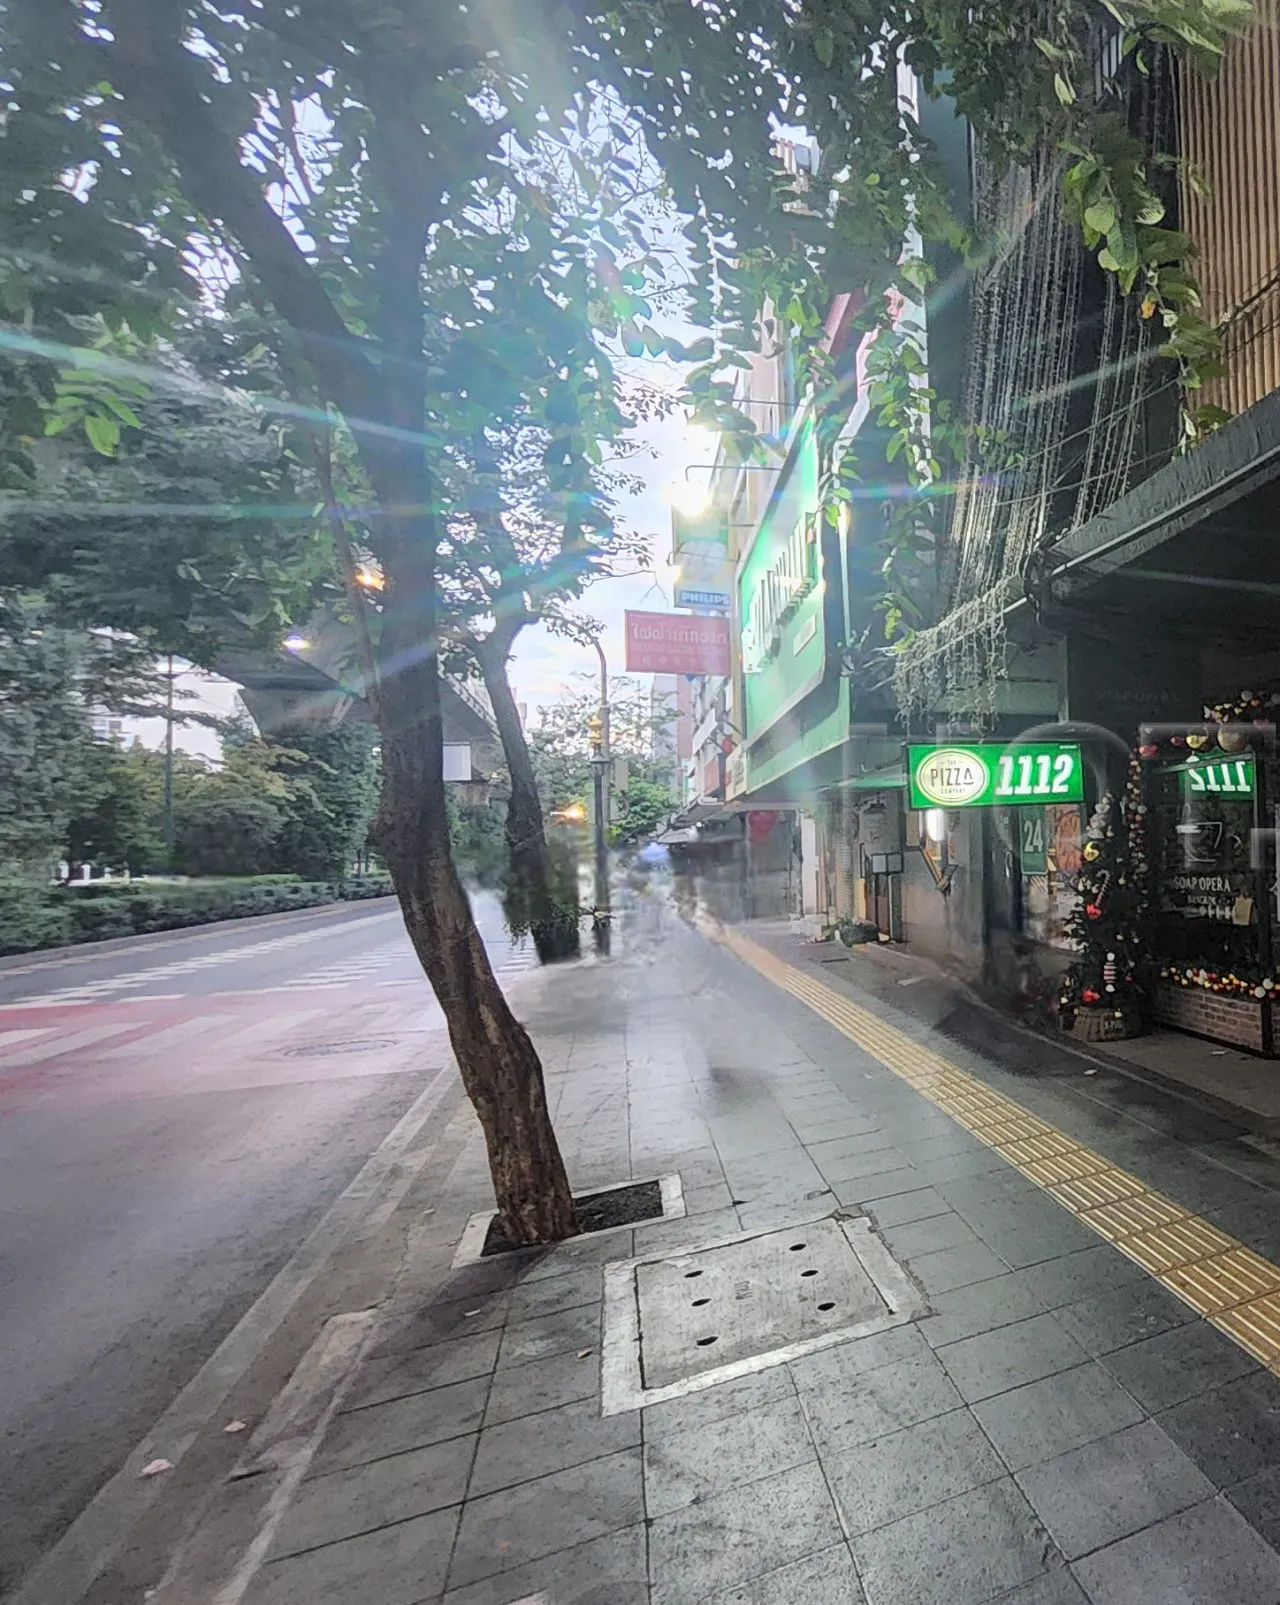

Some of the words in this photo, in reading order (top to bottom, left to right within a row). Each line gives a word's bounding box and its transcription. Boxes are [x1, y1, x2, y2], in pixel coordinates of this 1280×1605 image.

[681, 591, 729, 605] PHILIPS
[930, 767, 975, 787] PIZZA
[995, 754, 1074, 795] 1112
[1024, 819, 1043, 852] 24
[1174, 876, 1198, 891] SOAP
[1199, 875, 1231, 893] OPERA
